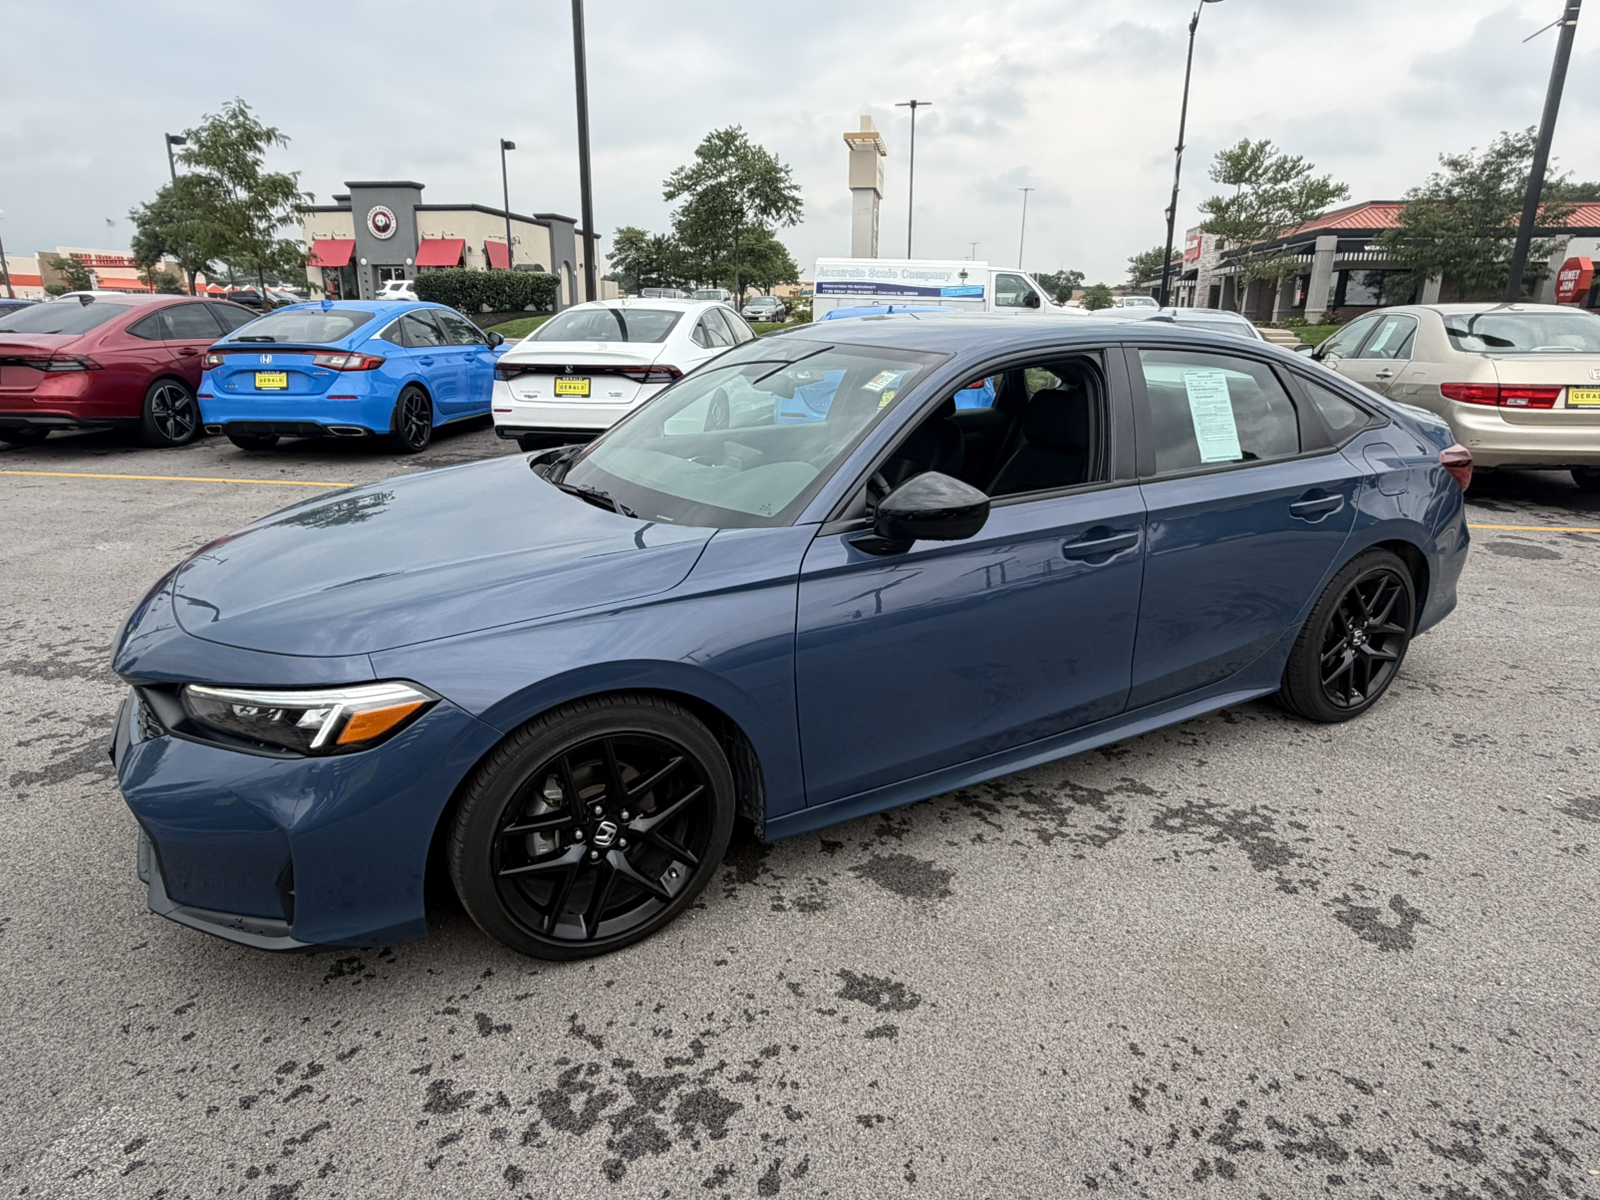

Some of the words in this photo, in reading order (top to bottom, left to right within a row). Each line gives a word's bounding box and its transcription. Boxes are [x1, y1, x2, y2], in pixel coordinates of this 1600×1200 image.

[817, 267, 866, 278] Accurate
[868, 268, 898, 279] Scale
[901, 269, 952, 281] Company
[1559, 280, 1575, 291] JAM
